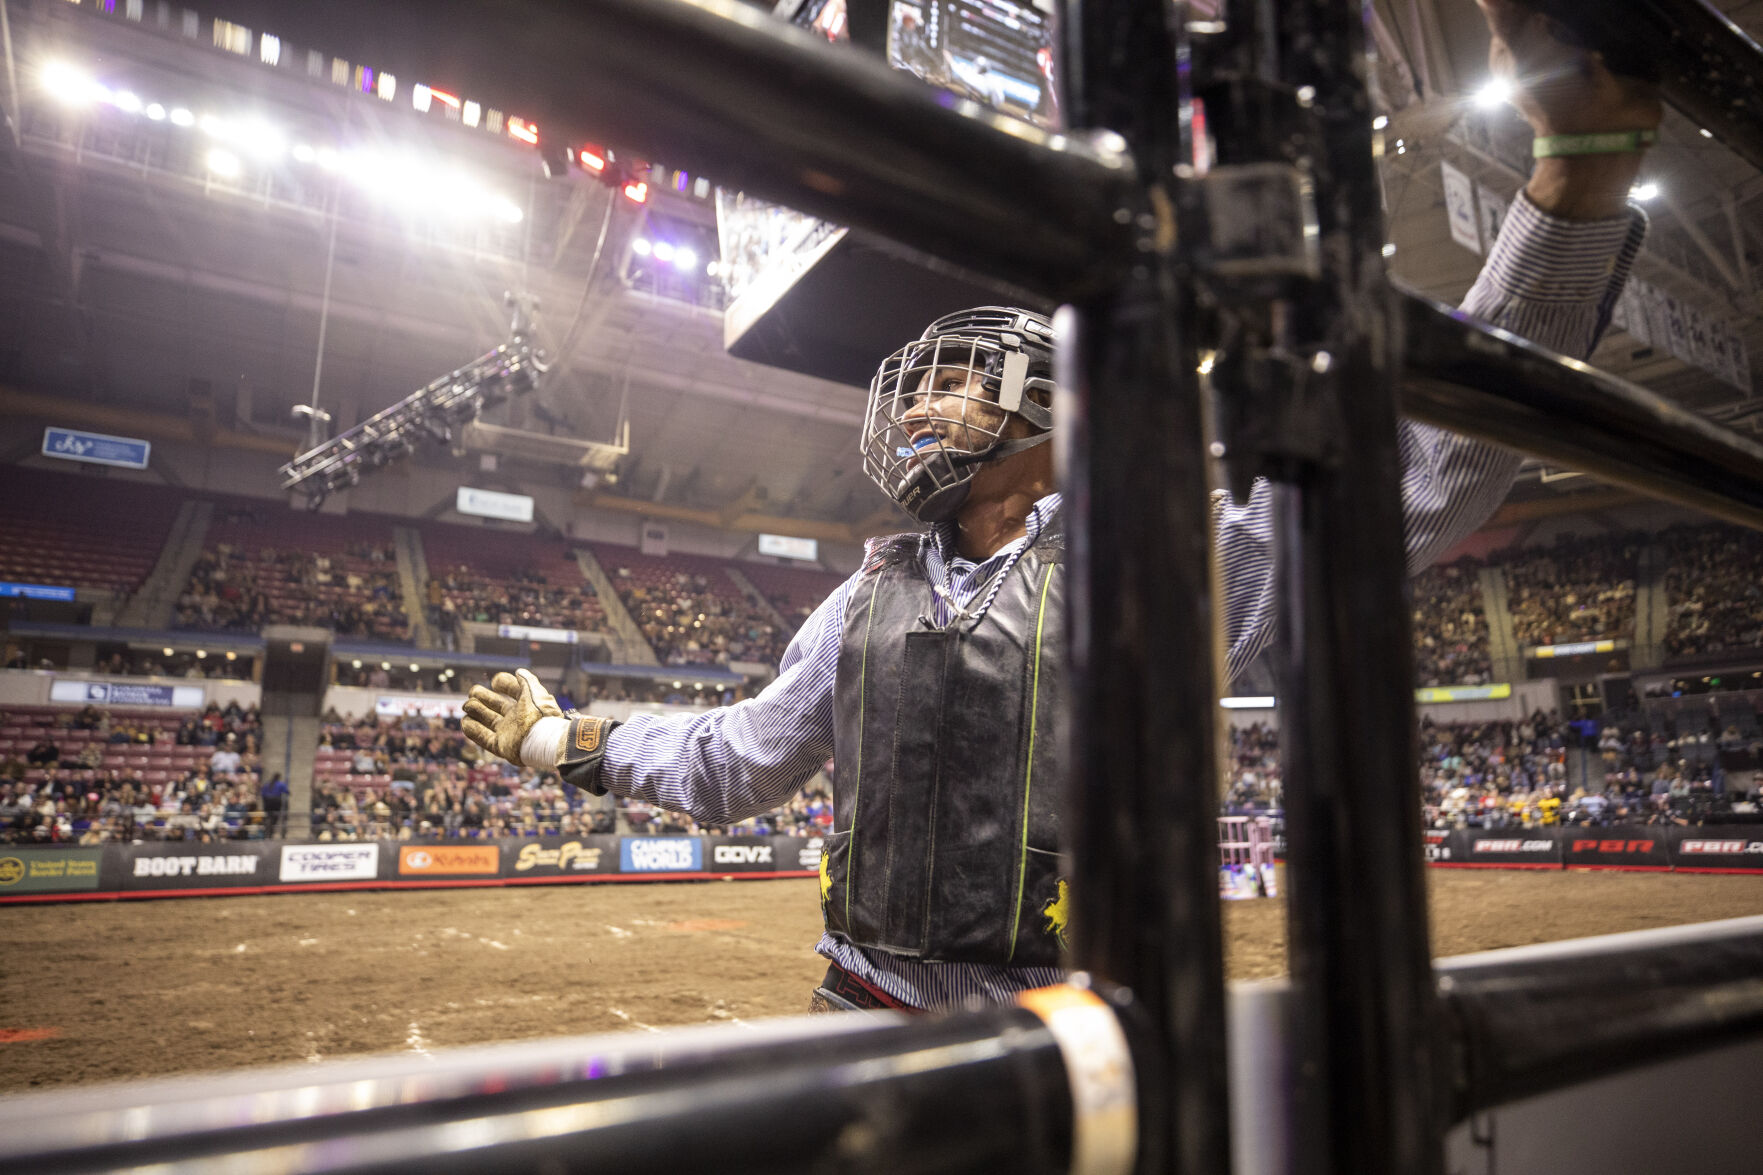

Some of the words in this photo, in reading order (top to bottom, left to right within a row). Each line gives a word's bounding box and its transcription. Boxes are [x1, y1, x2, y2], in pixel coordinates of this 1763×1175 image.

[1572, 840, 1654, 853] PBR
[288, 851, 371, 862] COOPER
[633, 852, 693, 869] WORLD
[714, 846, 772, 863] GOVX
[133, 856, 197, 877] BOOT
[196, 855, 258, 875] BARN
[300, 862, 356, 873] TIRES
